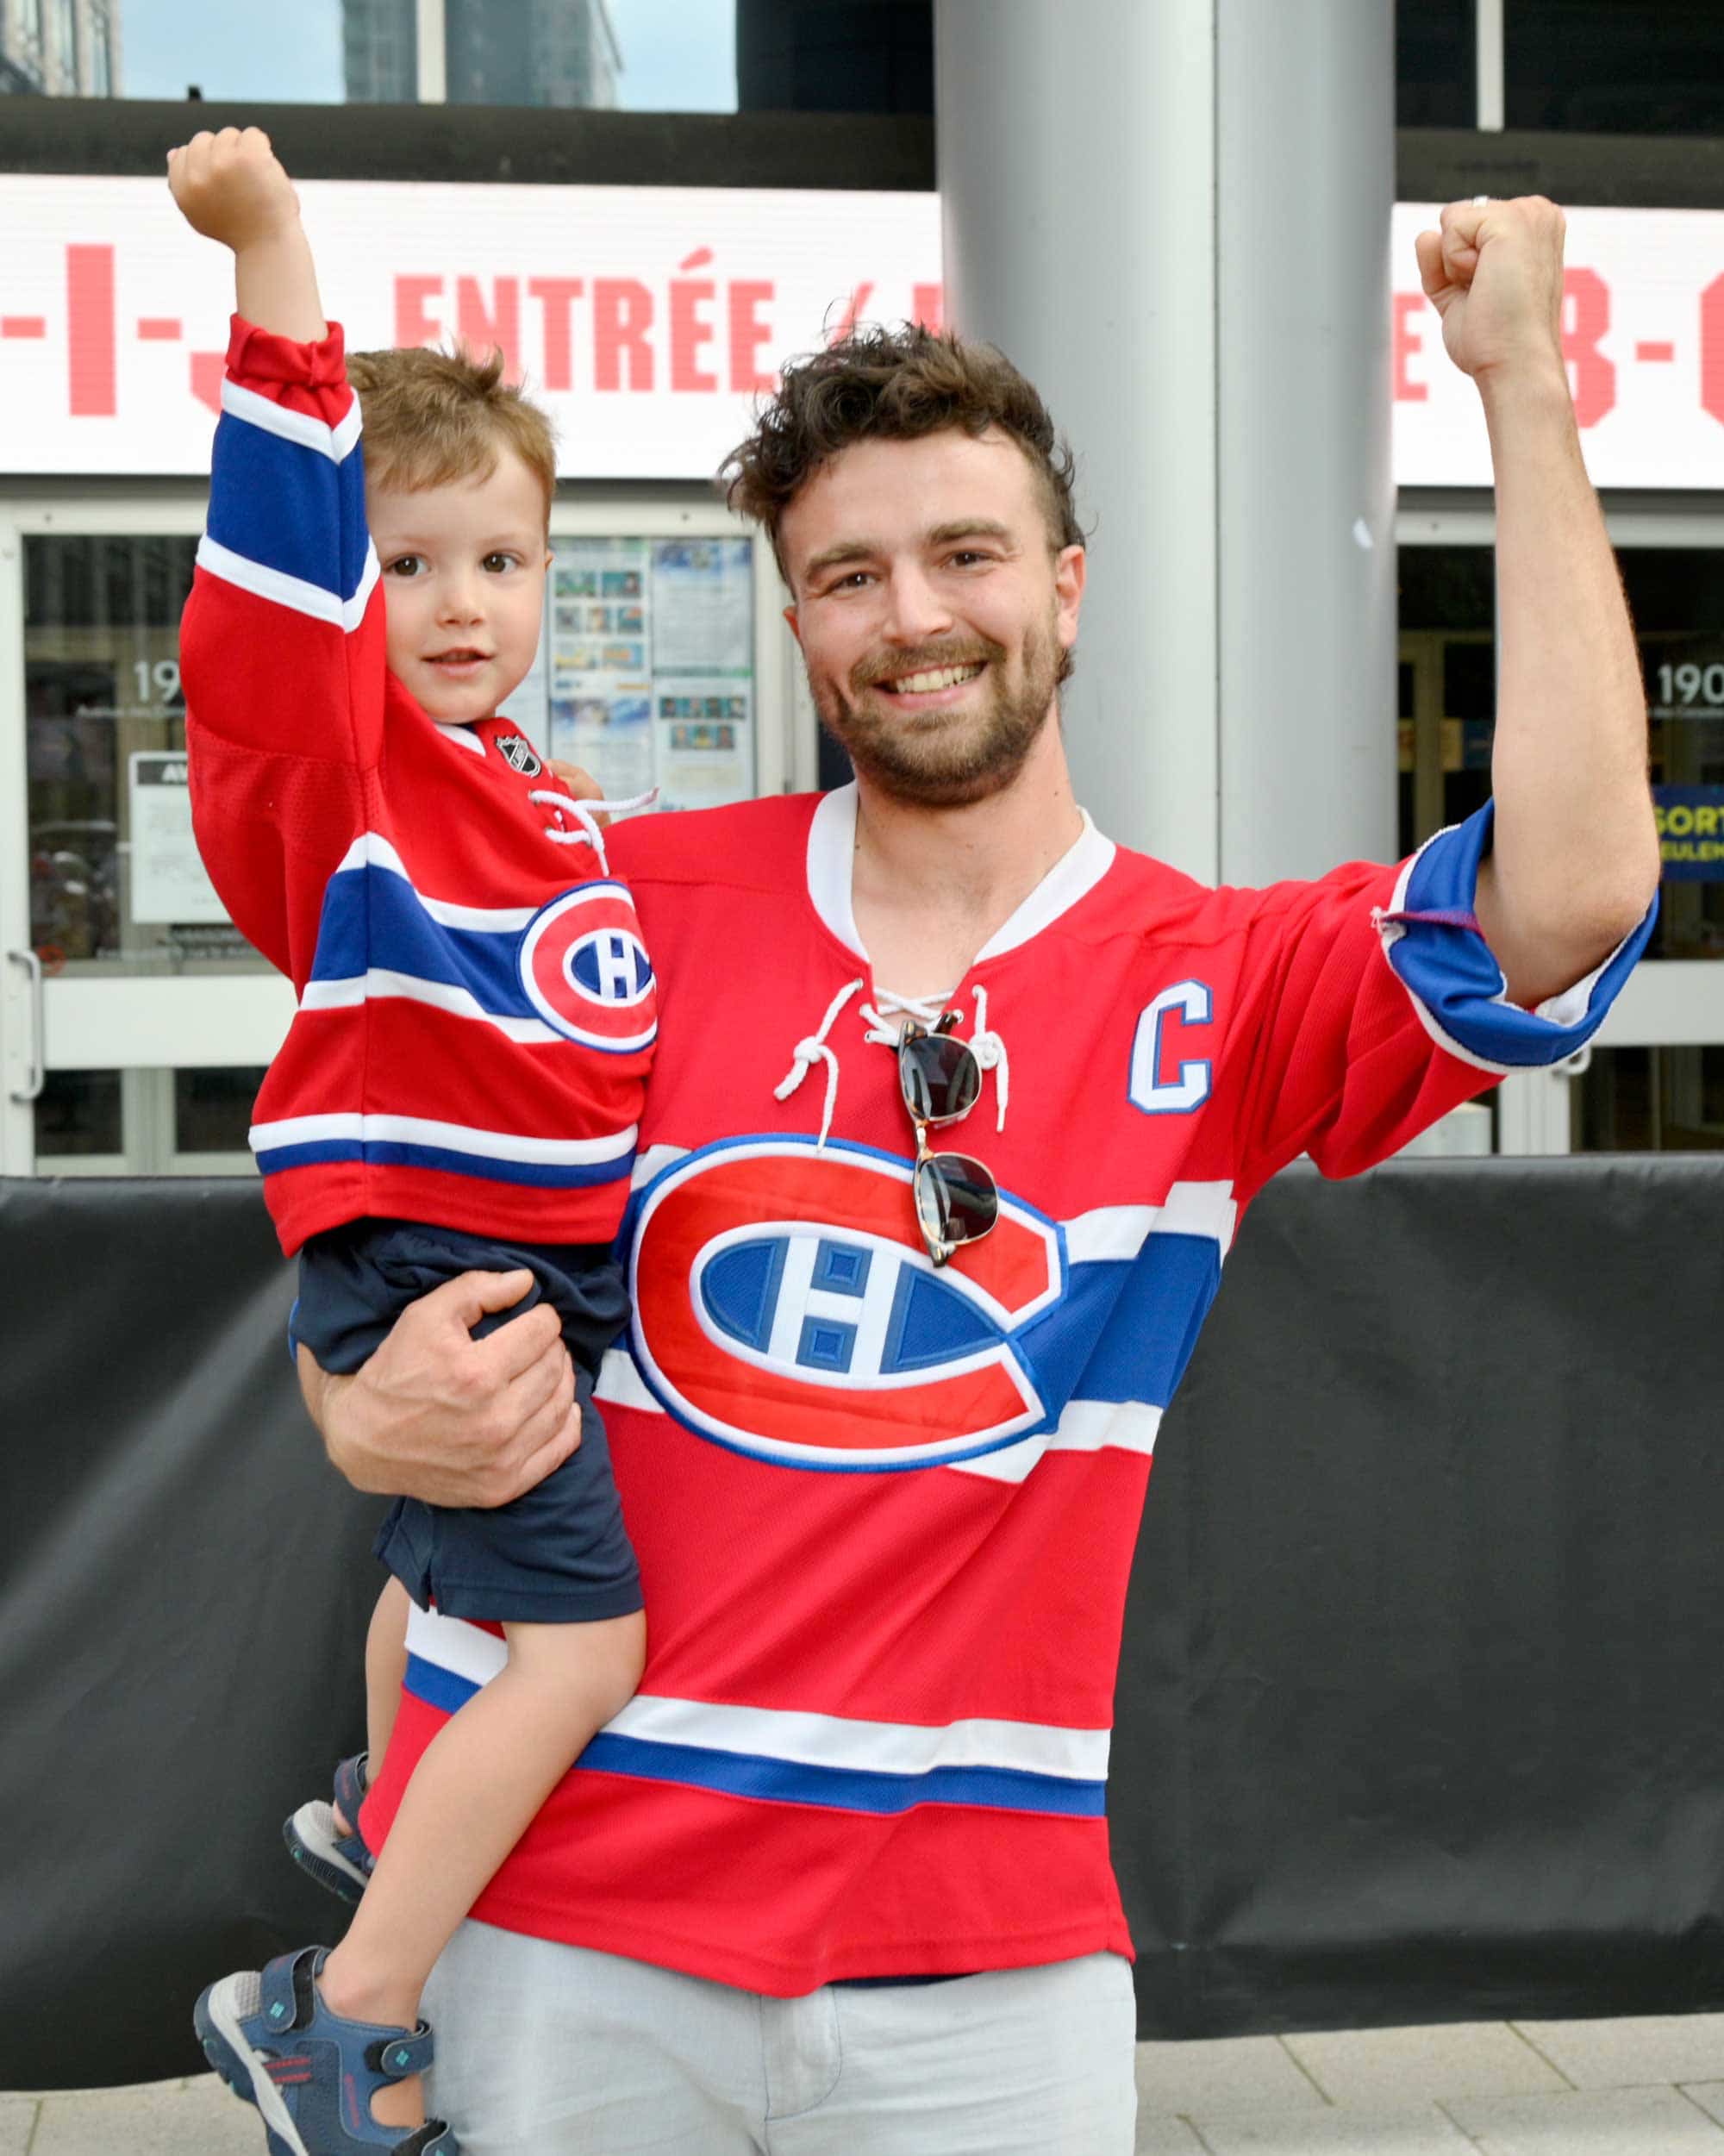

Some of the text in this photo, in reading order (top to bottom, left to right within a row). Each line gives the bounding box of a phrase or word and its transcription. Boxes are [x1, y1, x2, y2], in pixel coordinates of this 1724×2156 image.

[392, 246, 780, 392] ENTRÉE
[1658, 663, 1724, 703] 190
[1127, 978, 1214, 1115] C
